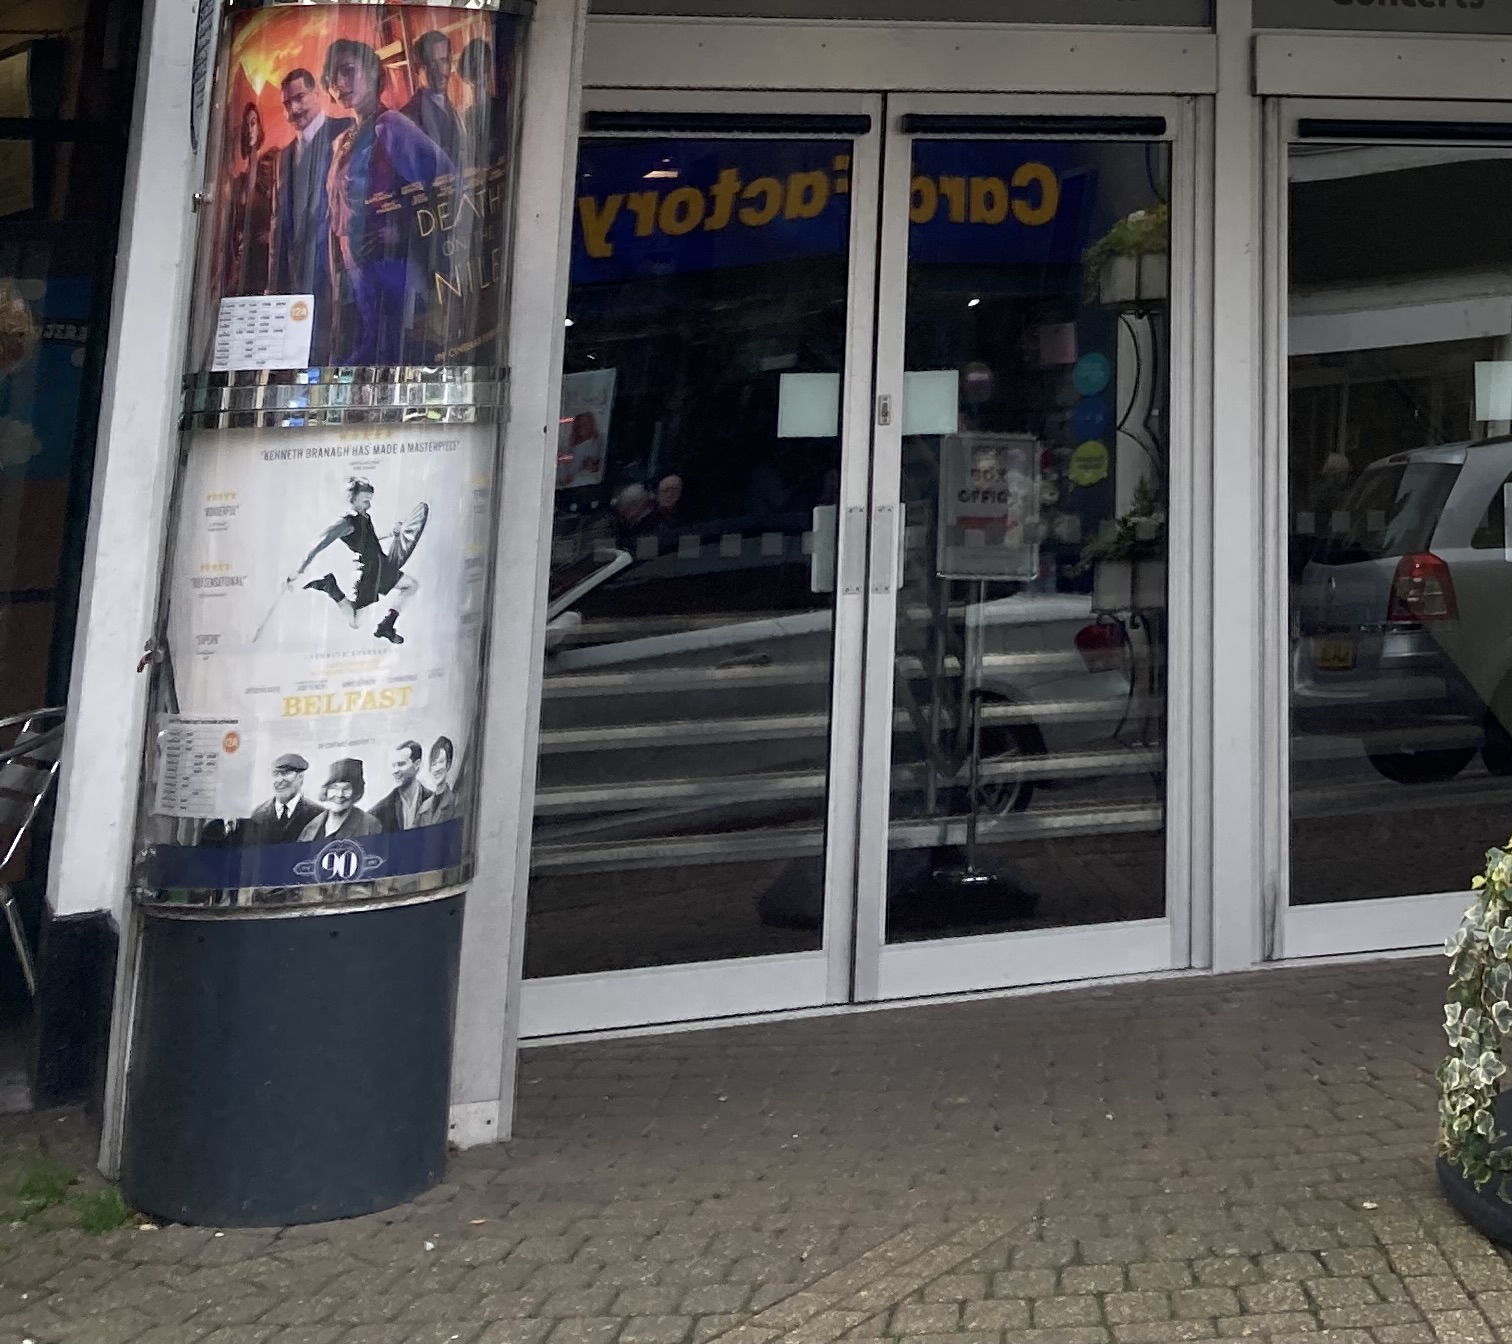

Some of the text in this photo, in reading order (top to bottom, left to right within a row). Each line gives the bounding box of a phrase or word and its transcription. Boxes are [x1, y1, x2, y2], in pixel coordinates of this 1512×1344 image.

[416, 184, 501, 238] DEATH
[442, 238, 467, 257] ON
[434, 247, 501, 306] NILE
[305, 446, 350, 459] BRANAGH
[352, 444, 370, 456] HAS
[373, 442, 398, 455] MADE
[399, 442, 406, 454] A
[281, 685, 413, 718] BELFAST
[321, 851, 358, 880] 90
